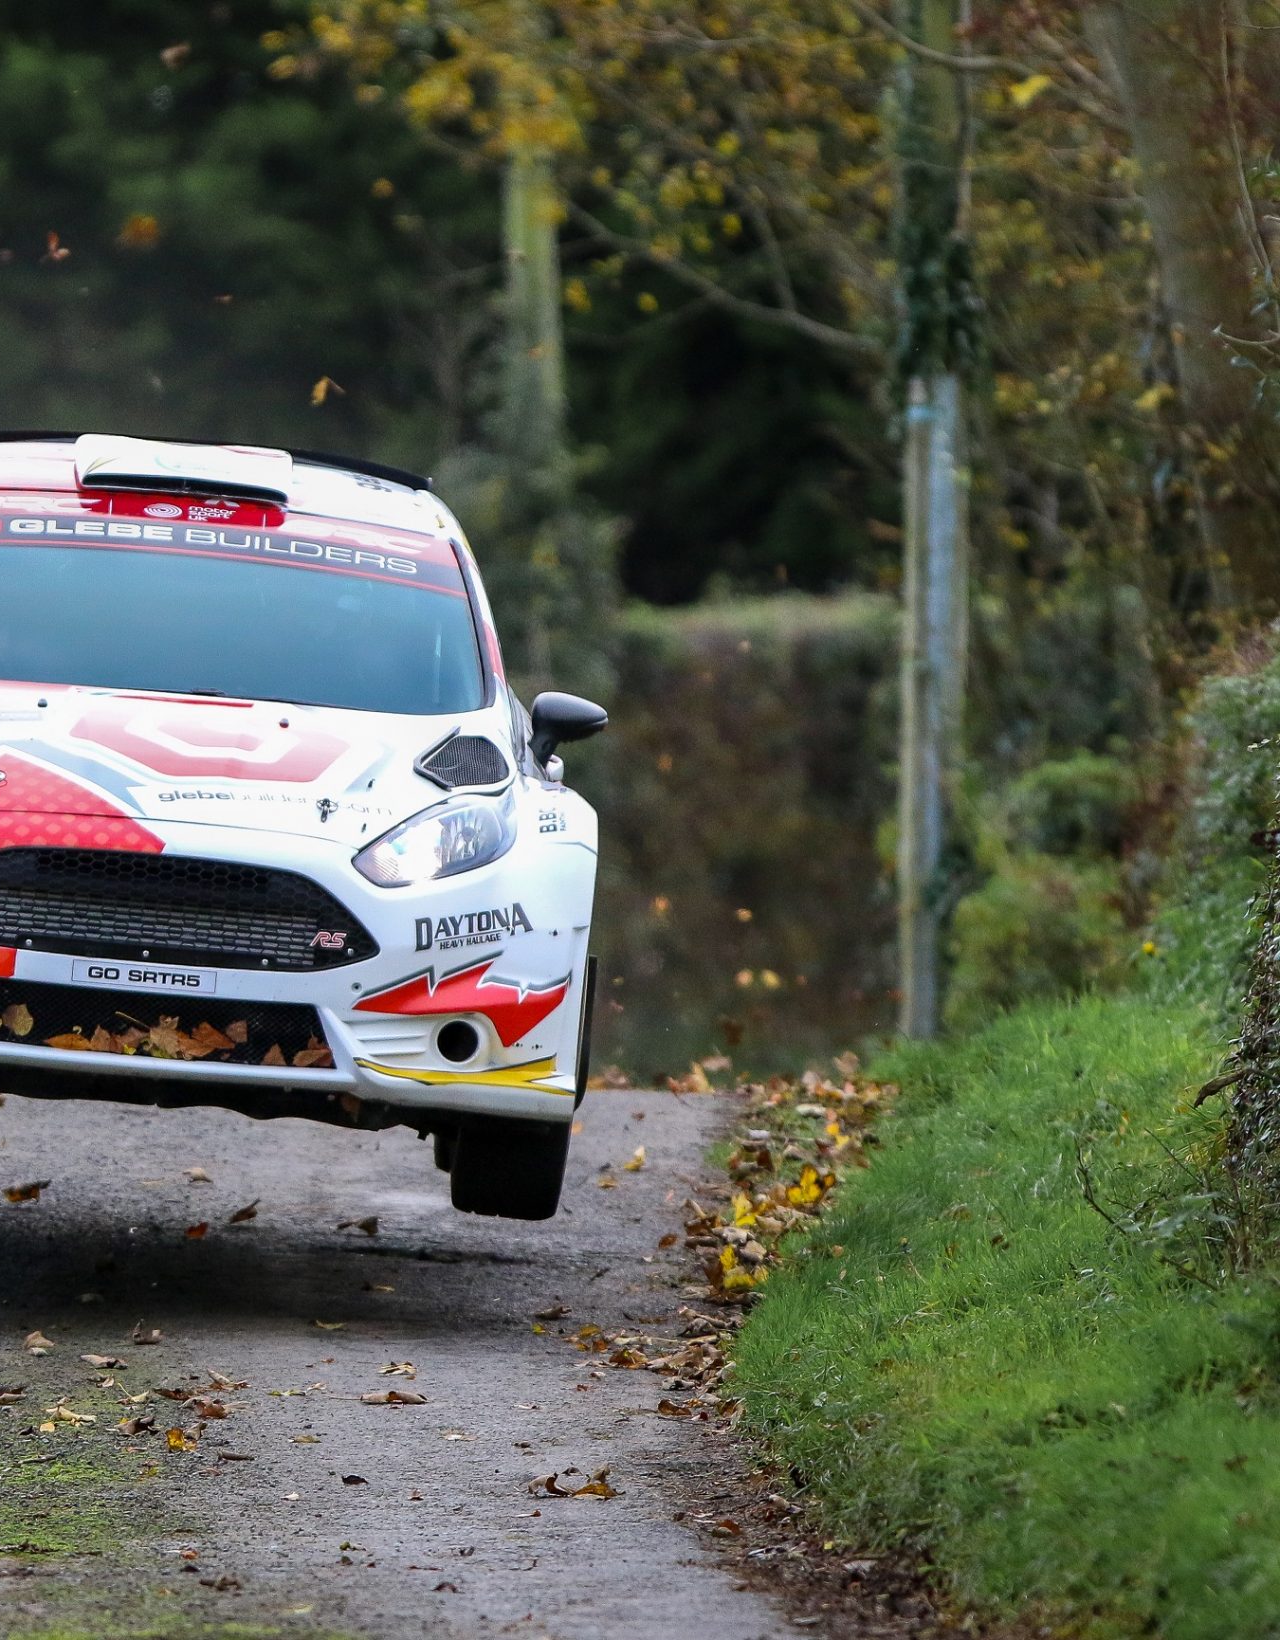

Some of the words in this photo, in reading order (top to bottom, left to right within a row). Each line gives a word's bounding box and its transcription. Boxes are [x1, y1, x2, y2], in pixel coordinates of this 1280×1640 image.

[189, 505, 236, 515] motor
[189, 511, 230, 519] sport
[9, 518, 173, 541] GLEBE
[185, 528, 418, 574] BUILDERS
[415, 902, 533, 952] DAYTONA
[310, 931, 347, 948] RS
[439, 939, 465, 950] HEAVY
[466, 932, 503, 946] HAULAGE
[87, 965, 120, 980] GO
[128, 969, 201, 987] SRTR5
